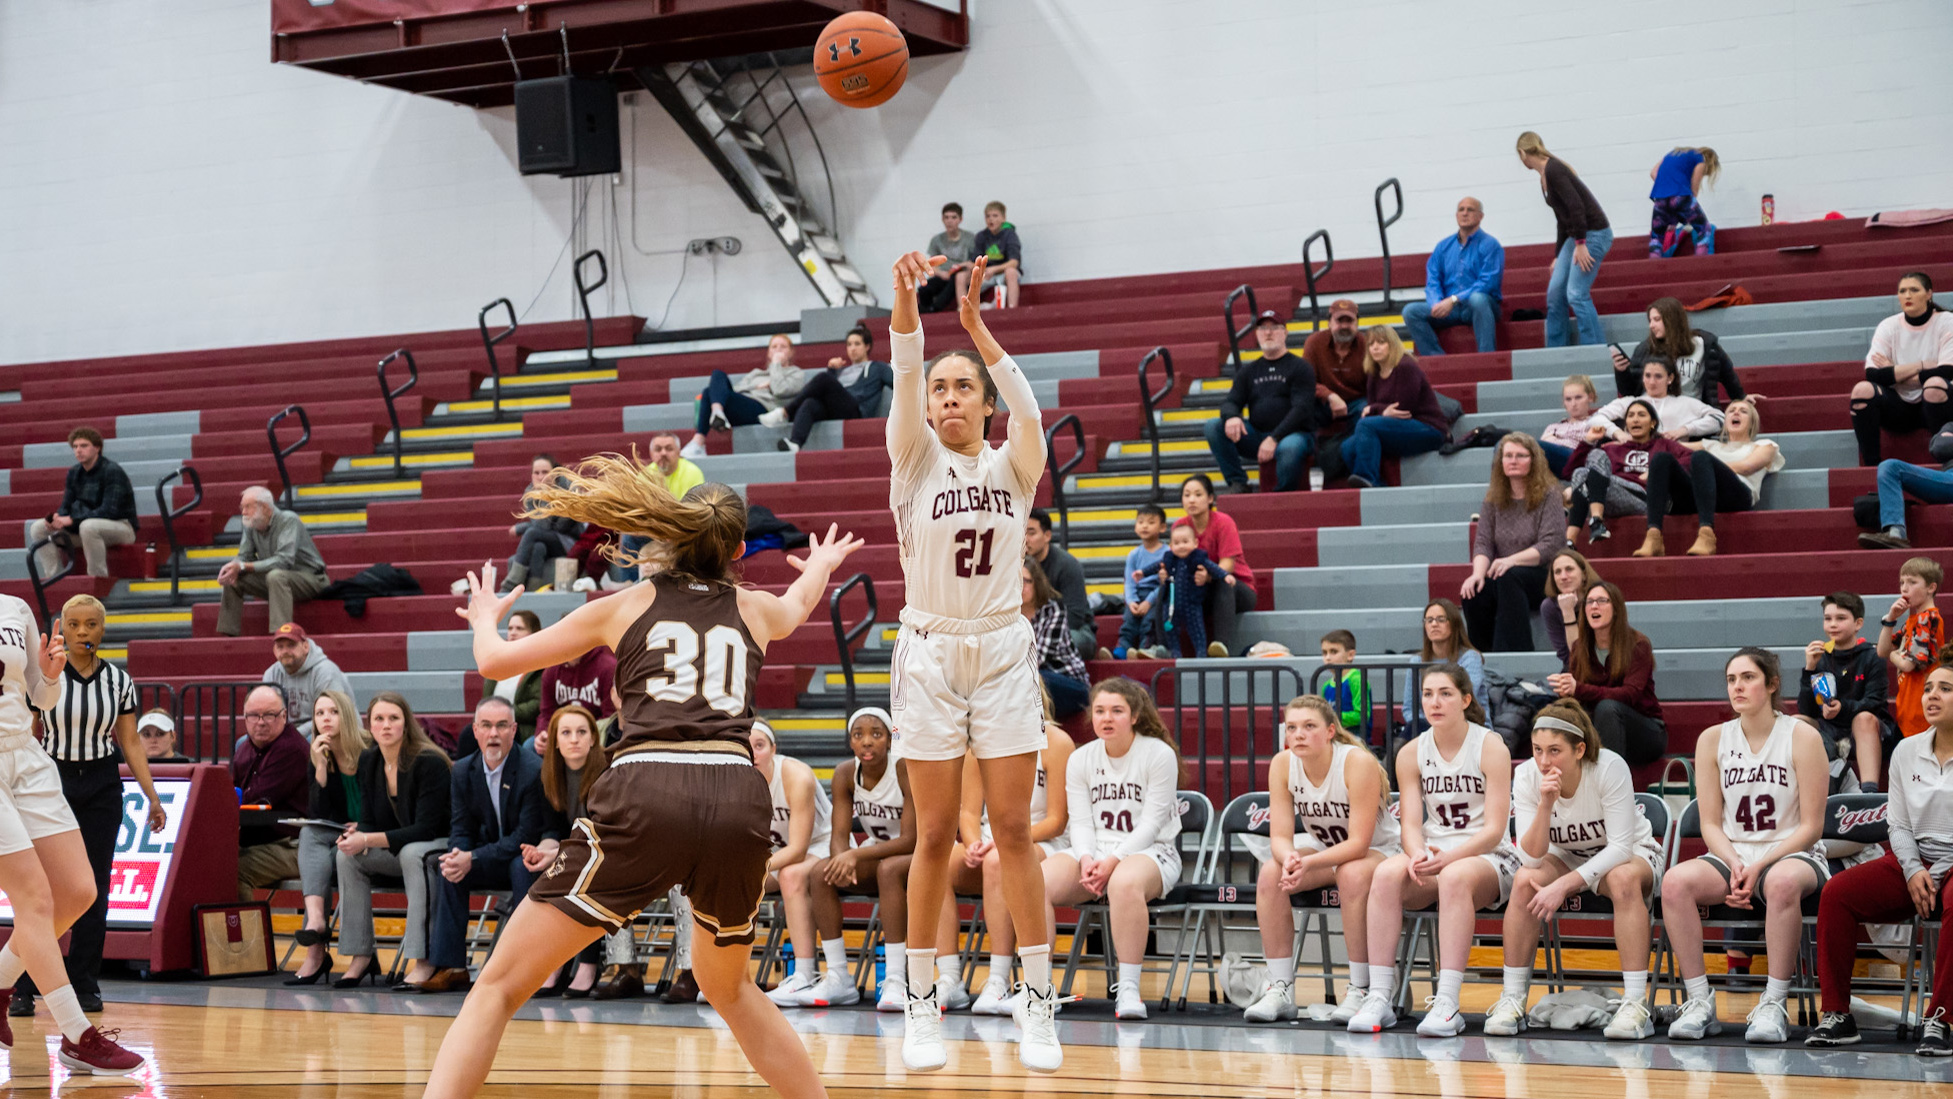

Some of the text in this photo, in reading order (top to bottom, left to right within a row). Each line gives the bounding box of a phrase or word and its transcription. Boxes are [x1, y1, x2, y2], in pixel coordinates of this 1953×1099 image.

[932, 485, 1015, 521] COLGATE
[954, 527, 995, 578] 21
[645, 620, 748, 718] 30
[1724, 763, 1789, 790] COLGATE
[1091, 782, 1142, 805] COLGATE
[1294, 800, 1350, 819] OLGATE
[1436, 802, 1471, 829] 15
[1735, 793, 1777, 832] 42
[1218, 886, 1237, 902] 13
[1321, 890, 1340, 906] 13
